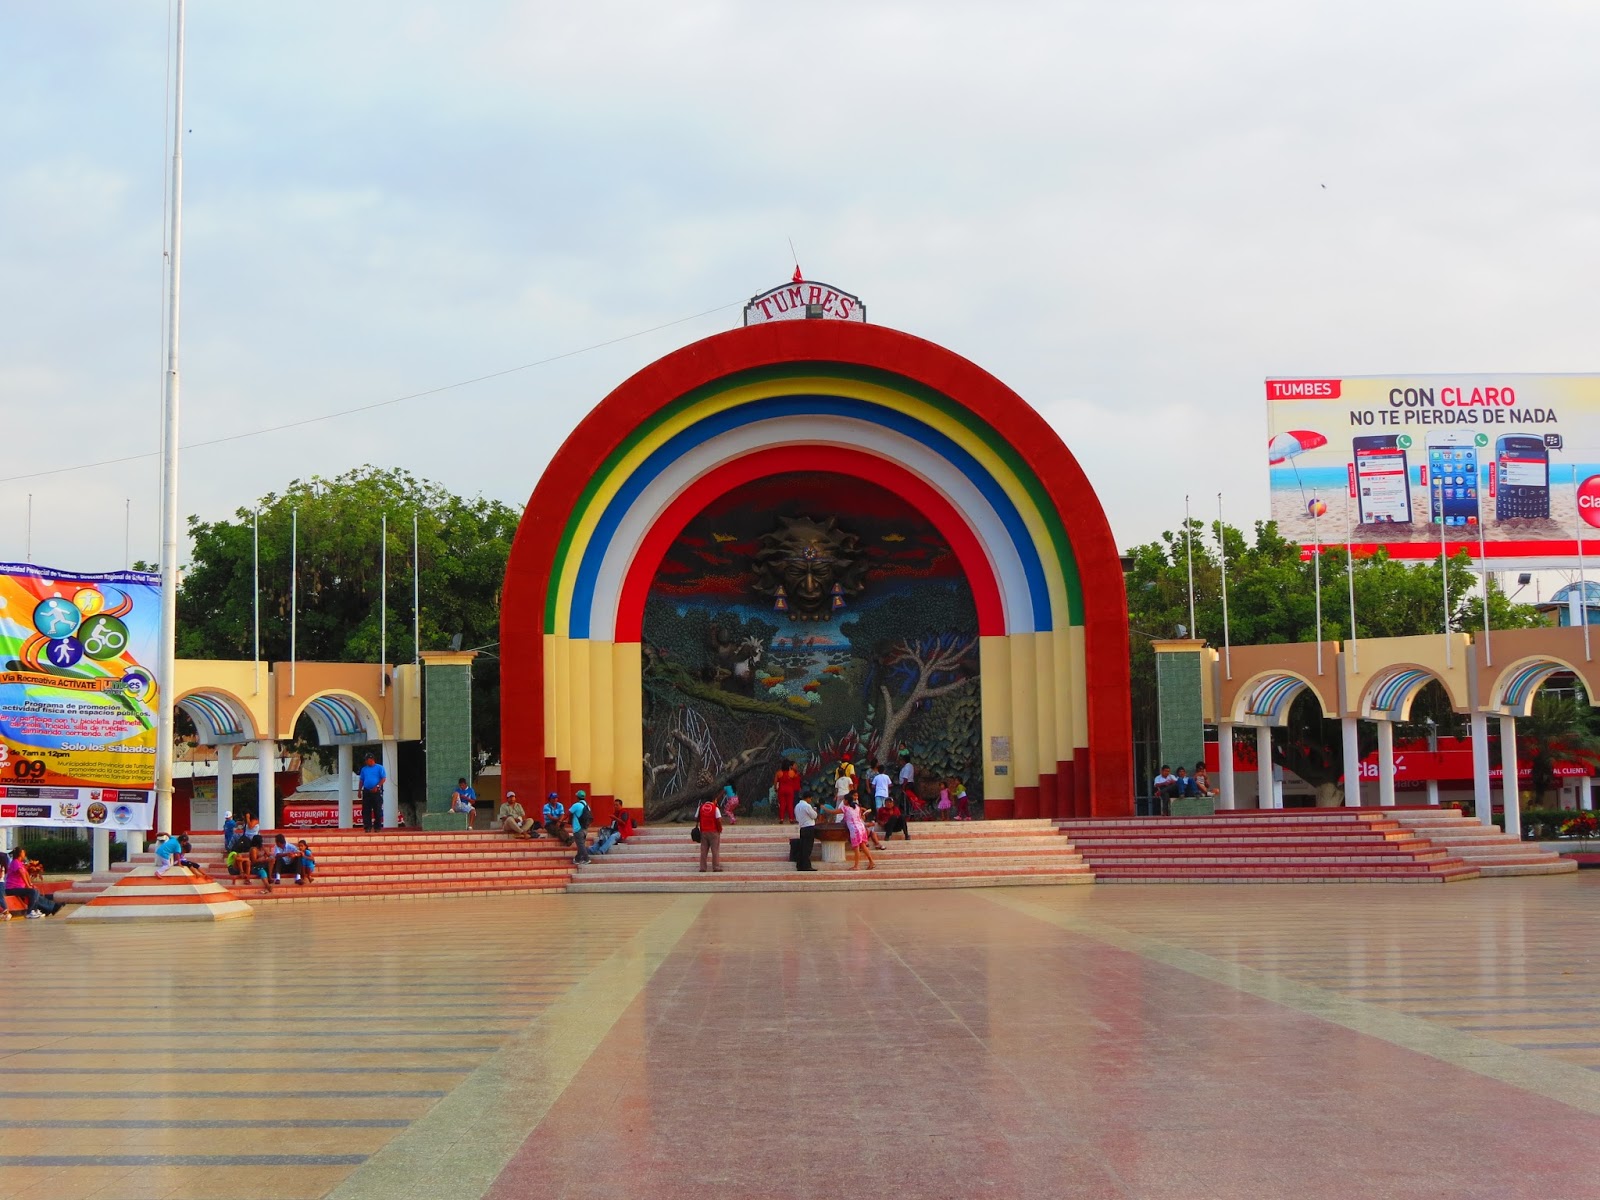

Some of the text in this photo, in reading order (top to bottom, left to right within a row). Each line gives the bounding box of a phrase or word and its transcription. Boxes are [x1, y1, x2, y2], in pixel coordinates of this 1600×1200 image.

[755, 285, 855, 320] TUMBES
[1273, 383, 1331, 395] TUMBES
[1389, 387, 1515, 407] CON CLARO
[1350, 408, 1559, 425] NO TE PIERDAS DE NADA
[1579, 494, 1600, 508] Cla
[0, 565, 25, 573] nicipalidad
[24, 700, 63, 710] Programa
[79, 709, 114, 717] espacios
[60, 741, 86, 752] Solo
[89, 742, 105, 752] los
[48, 750, 70, 758] 12pm
[14, 759, 46, 779] 09
